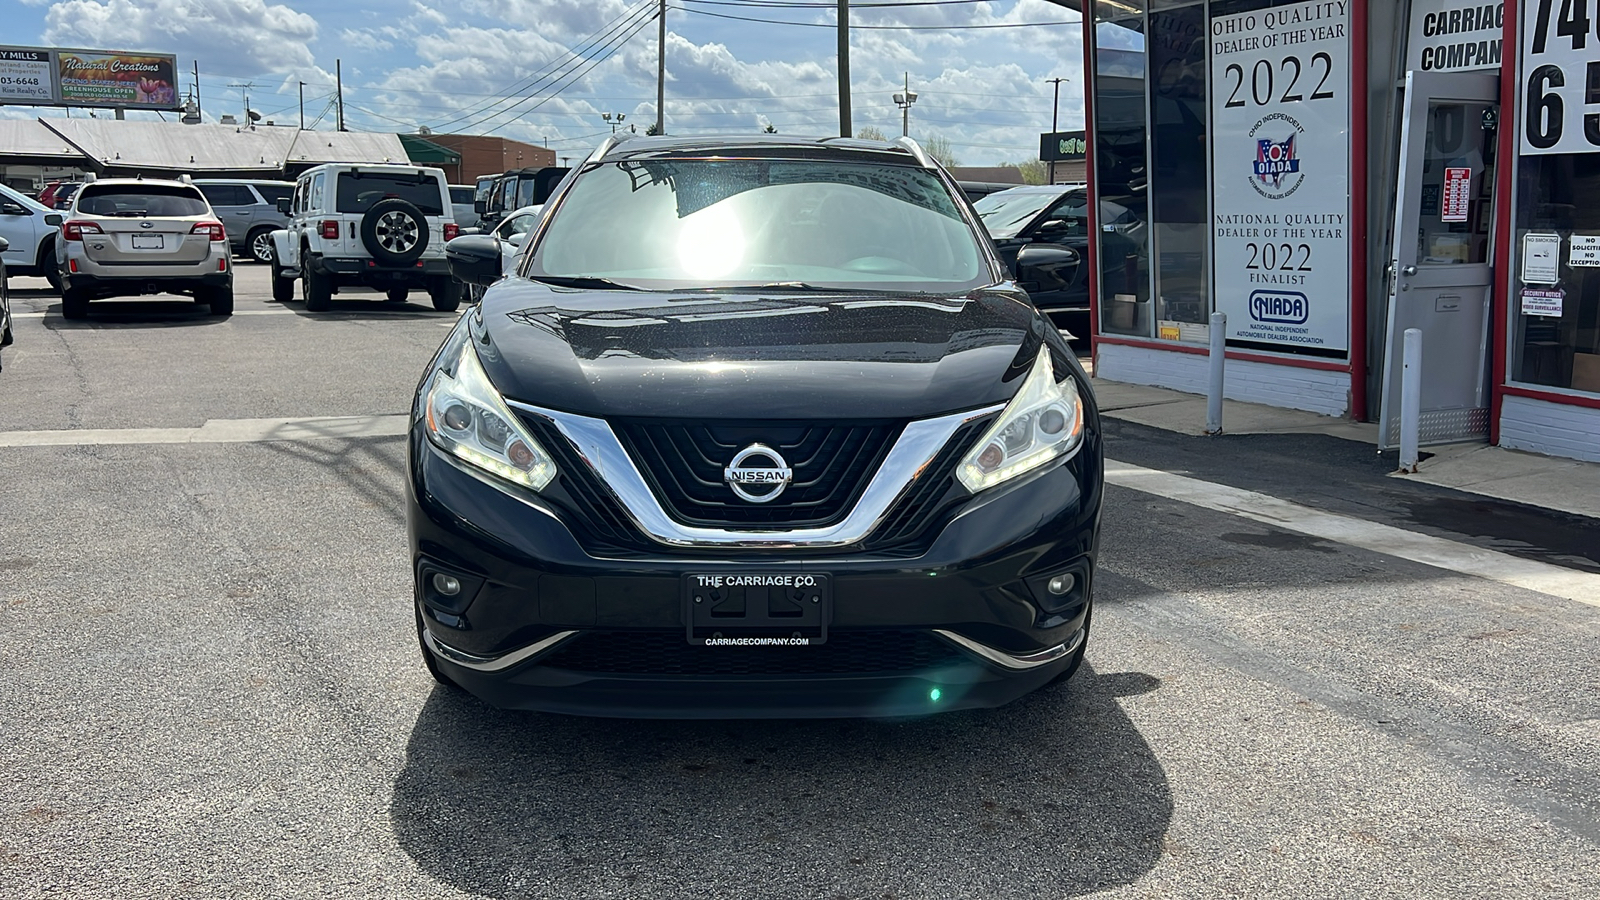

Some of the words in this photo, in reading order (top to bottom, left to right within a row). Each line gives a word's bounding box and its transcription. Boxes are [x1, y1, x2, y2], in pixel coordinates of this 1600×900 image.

[1213, 16, 1256, 36] OHIO
[1264, 0, 1347, 30] QUALITY
[1215, 37, 1260, 54] DEALER
[1262, 34, 1279, 48] OF
[1282, 30, 1307, 45] THE
[1310, 24, 1345, 41] YEAR
[64, 58, 108, 70] Natural
[110, 60, 160, 72] Creations
[1224, 52, 1334, 108] 2022
[17, 87, 36, 96] Realty
[1248, 120, 1262, 138] OHIO
[1262, 113, 1305, 134] INDEPENDENT
[1258, 161, 1292, 174] OIADA
[1248, 176, 1268, 198] AUTOMOBILE
[1284, 173, 1305, 198] ASSOCIATION
[1216, 214, 1279, 224] NATIONAL
[1285, 214, 1344, 226] QUALITY
[1218, 228, 1259, 237] DEALER
[1264, 228, 1278, 238] OF
[1283, 229, 1305, 238] THE
[1311, 229, 1342, 238] YEAR
[1246, 243, 1312, 272] 2022
[1250, 273, 1306, 284] FINALIST
[1254, 297, 1303, 317] NIADA
[1275, 326, 1308, 334] INDEPENDENT
[1237, 331, 1266, 339] AUTOMOBILE
[1289, 335, 1324, 344] ASSOCIATION
[732, 472, 784, 480] NISSAN
[697, 576, 723, 587] THE
[726, 576, 792, 586] CARRIAGE
[795, 576, 817, 586] CO.
